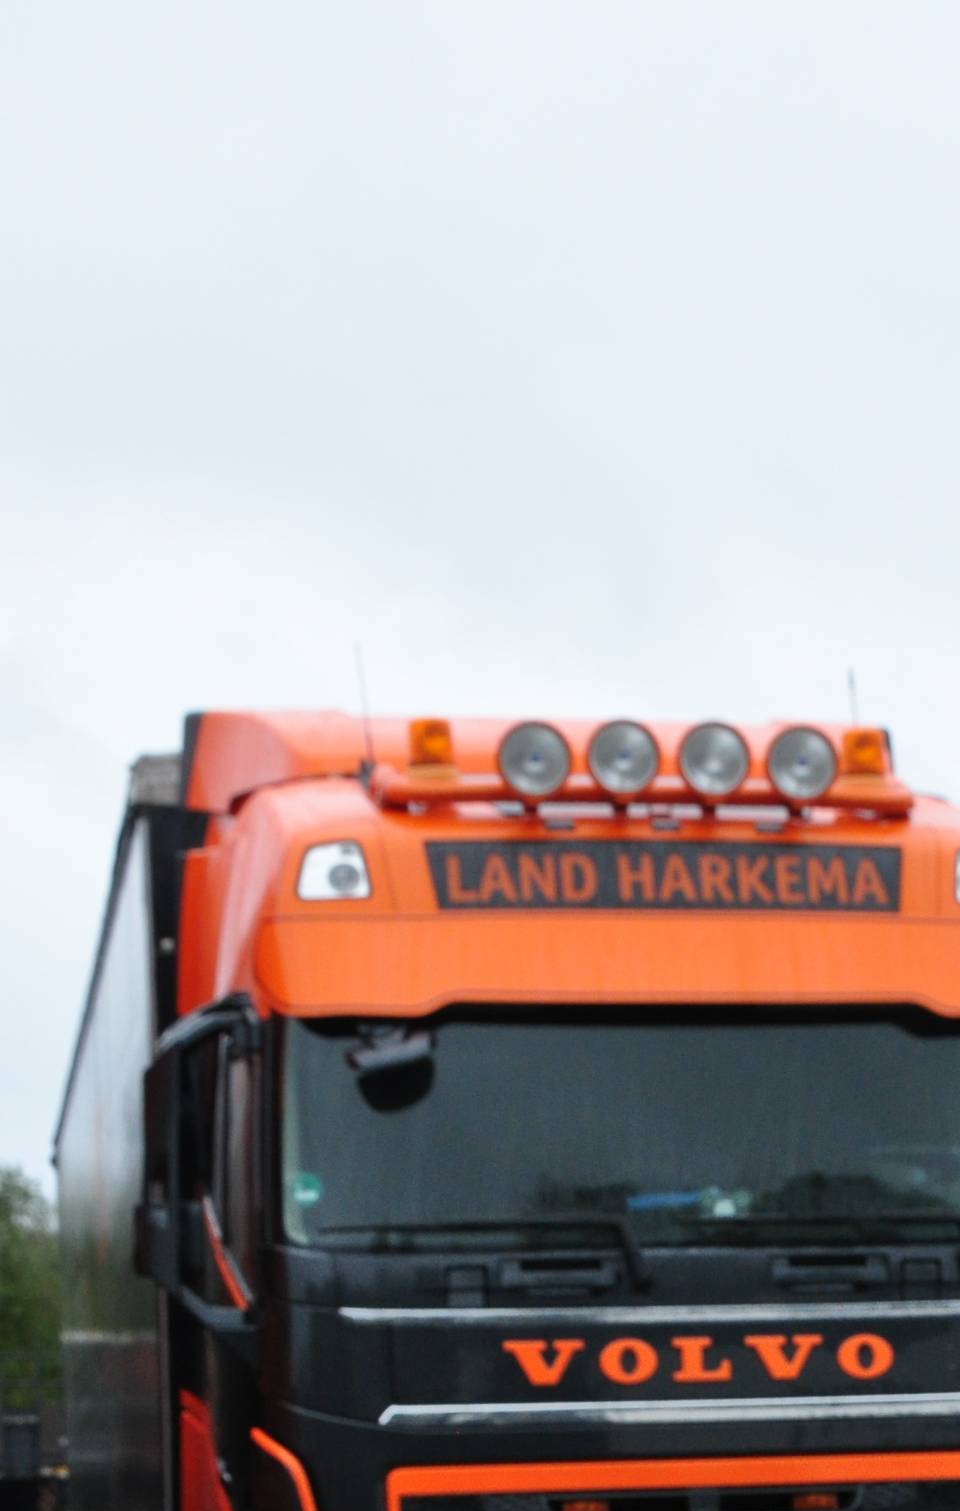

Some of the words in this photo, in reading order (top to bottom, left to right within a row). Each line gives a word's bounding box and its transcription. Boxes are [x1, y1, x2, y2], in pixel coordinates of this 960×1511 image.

[444, 852, 598, 901] LAND
[616, 852, 889, 906] HARKEMA
[502, 1332, 895, 1387] VOLVO
